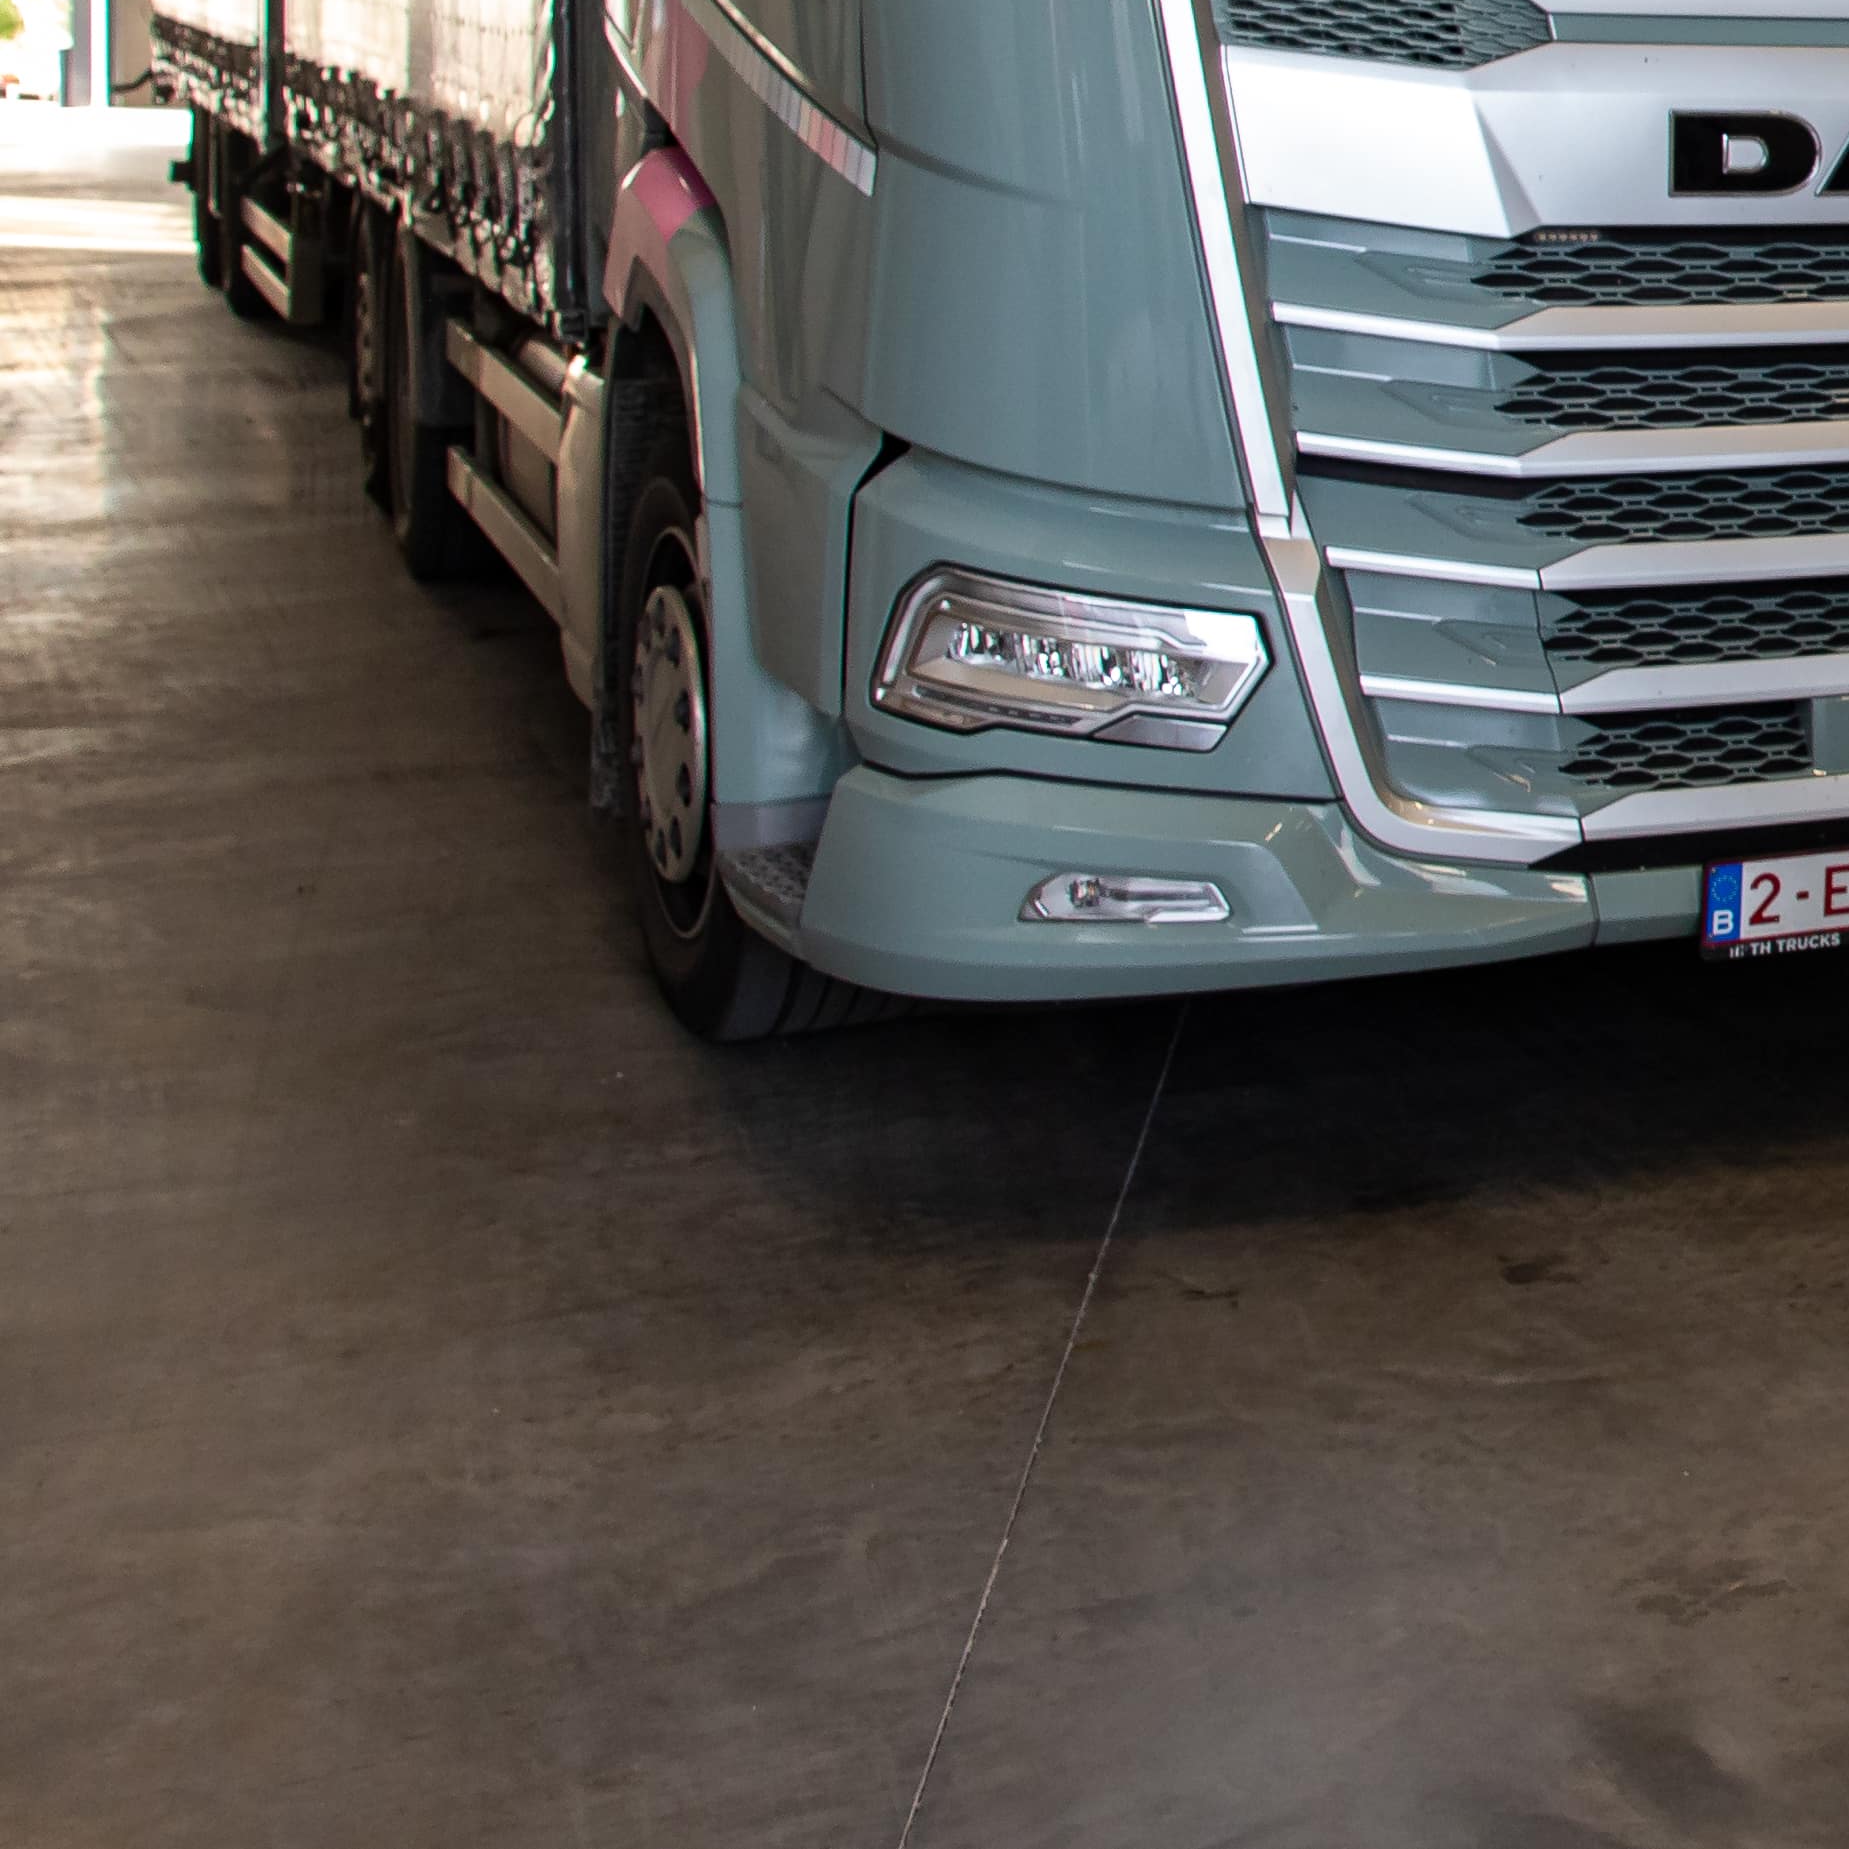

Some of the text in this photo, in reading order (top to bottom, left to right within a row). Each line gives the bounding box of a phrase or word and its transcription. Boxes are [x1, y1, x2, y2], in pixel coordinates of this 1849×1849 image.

[1711, 910, 1735, 935] B
[1750, 932, 1841, 956] TH TRUCKS
